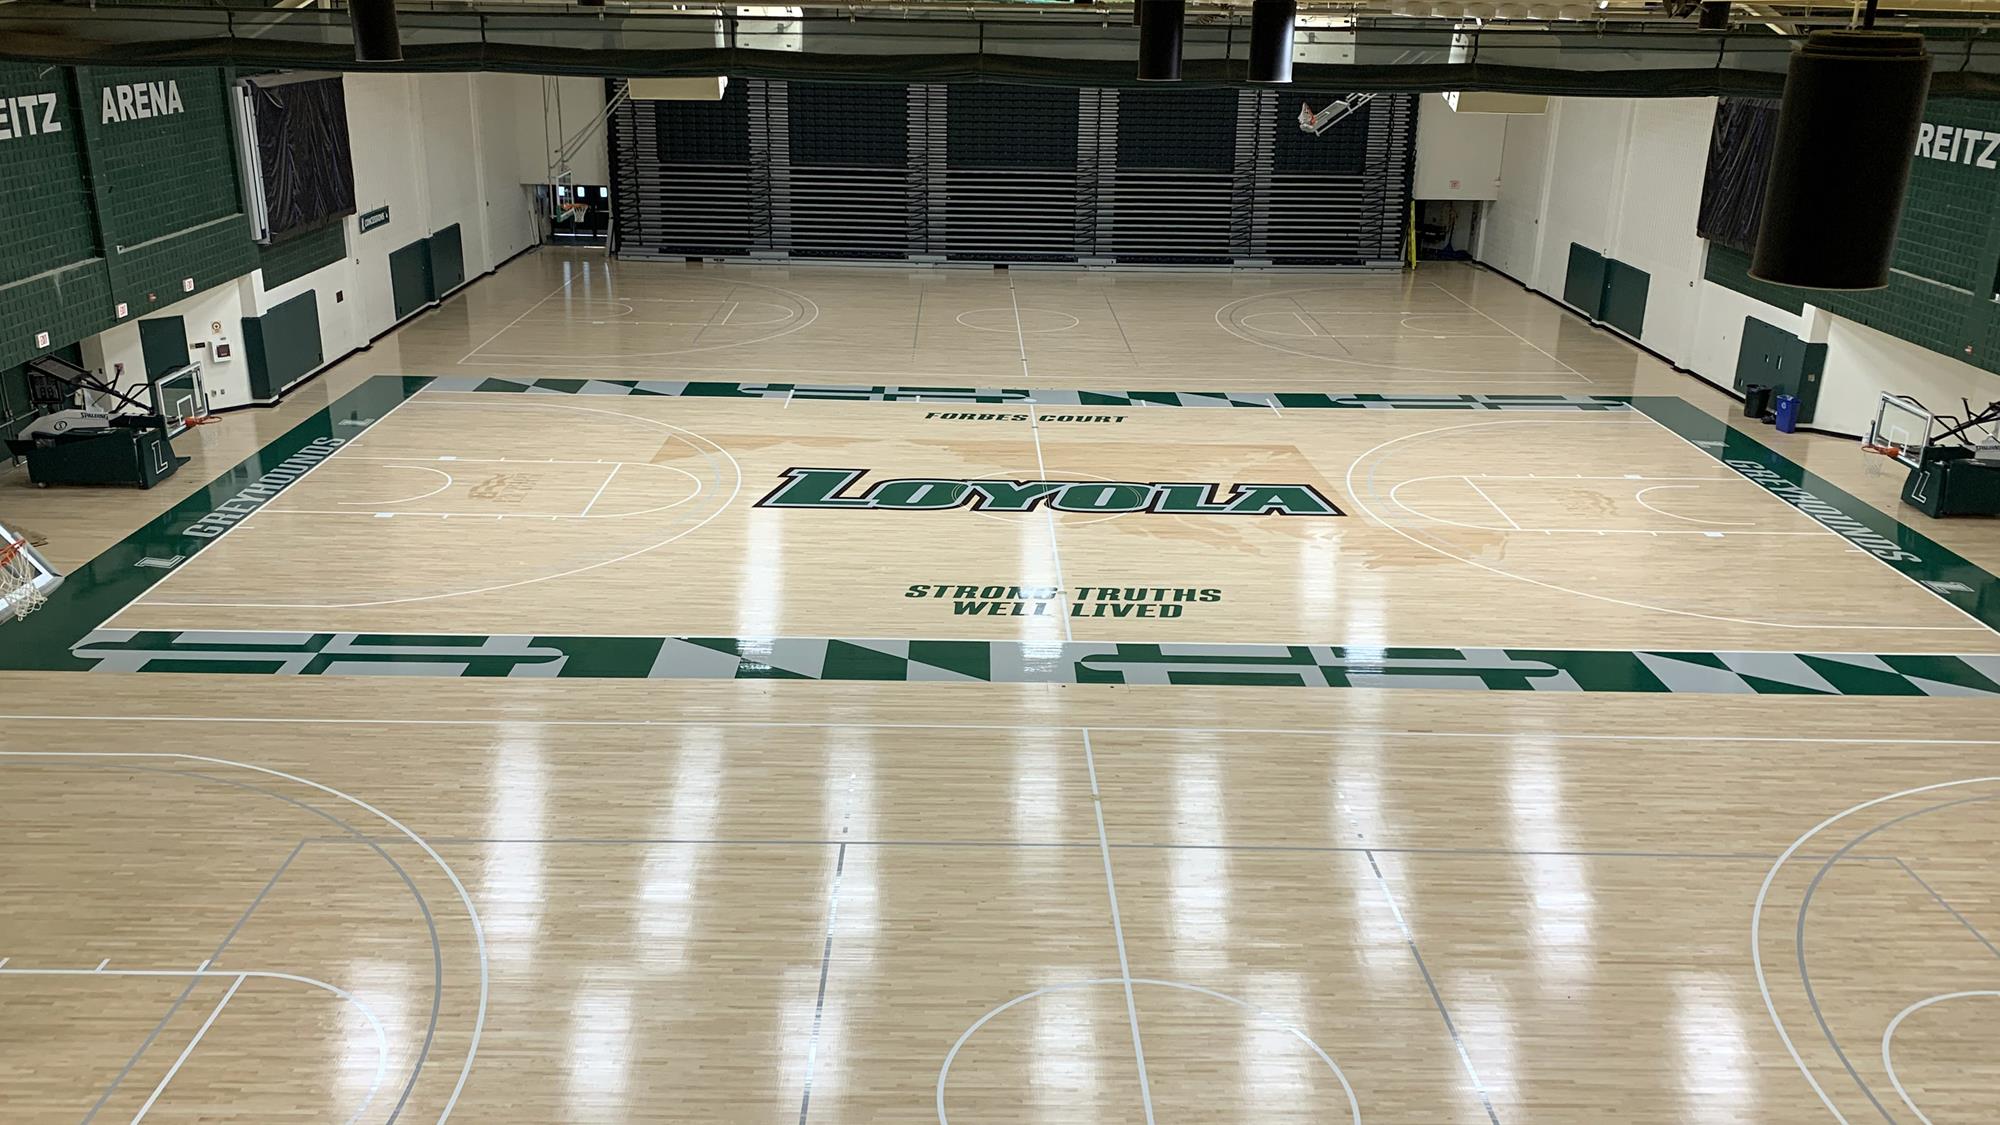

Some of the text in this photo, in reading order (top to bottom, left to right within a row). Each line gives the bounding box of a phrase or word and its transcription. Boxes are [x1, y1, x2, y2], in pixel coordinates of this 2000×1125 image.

[102, 80, 184, 124] ARENA
[1914, 122, 2000, 169] REITZ
[924, 412, 1128, 423] FORBES COURT
[151, 440, 168, 474] L
[182, 437, 346, 538] GREYHOUNDS
[751, 467, 1348, 517] LOYOLA
[1911, 470, 1930, 504] L
[1725, 459, 1922, 563] GREYHOUNDS
[905, 584, 1222, 602] STRONG TRUTHS
[953, 601, 1183, 618] WELL LIVED
